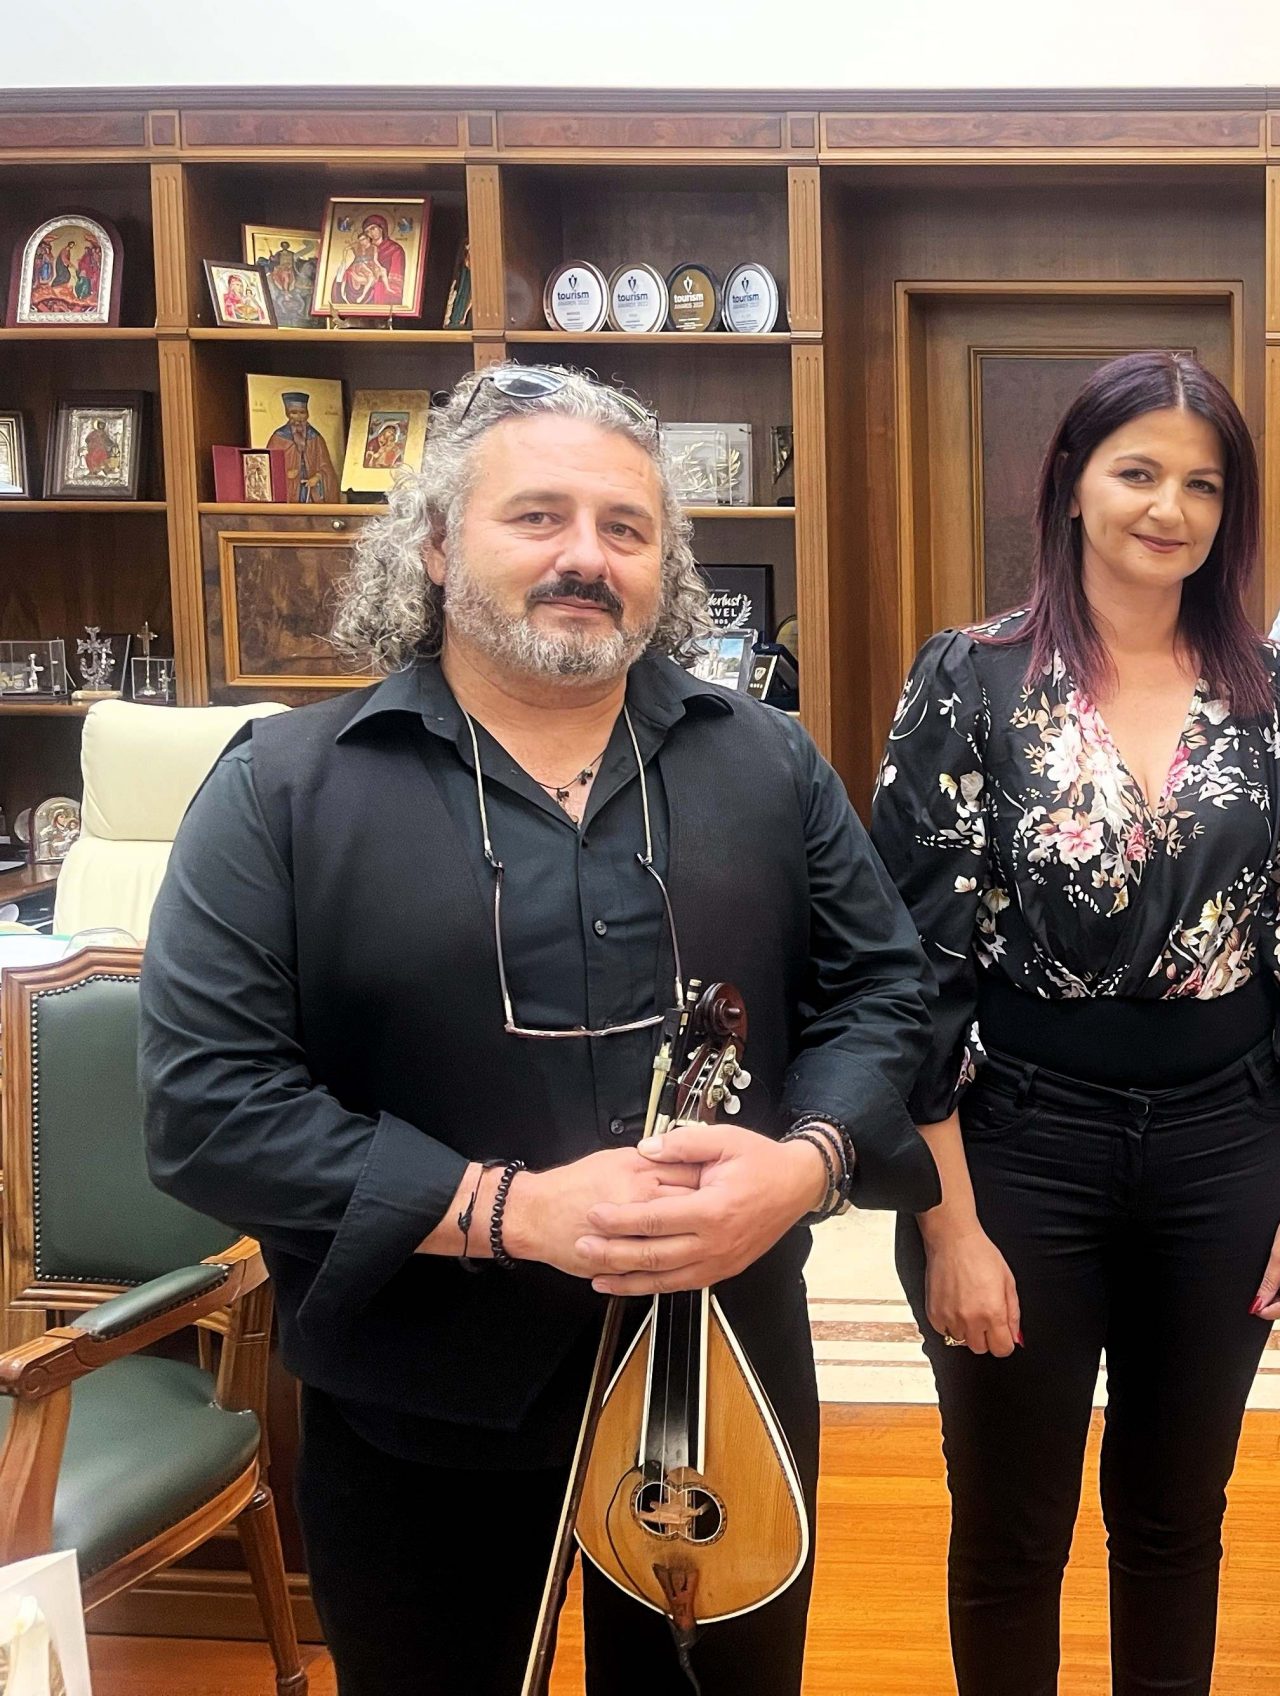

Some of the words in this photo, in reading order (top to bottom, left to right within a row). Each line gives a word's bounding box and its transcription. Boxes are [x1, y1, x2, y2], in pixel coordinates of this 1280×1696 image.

[557, 290, 590, 300] tourism
[617, 292, 648, 302] tourism
[673, 292, 704, 303] tourism
[732, 293, 760, 304] tourism
[707, 593, 743, 607] derlust
[707, 606, 738, 618] AVEL
